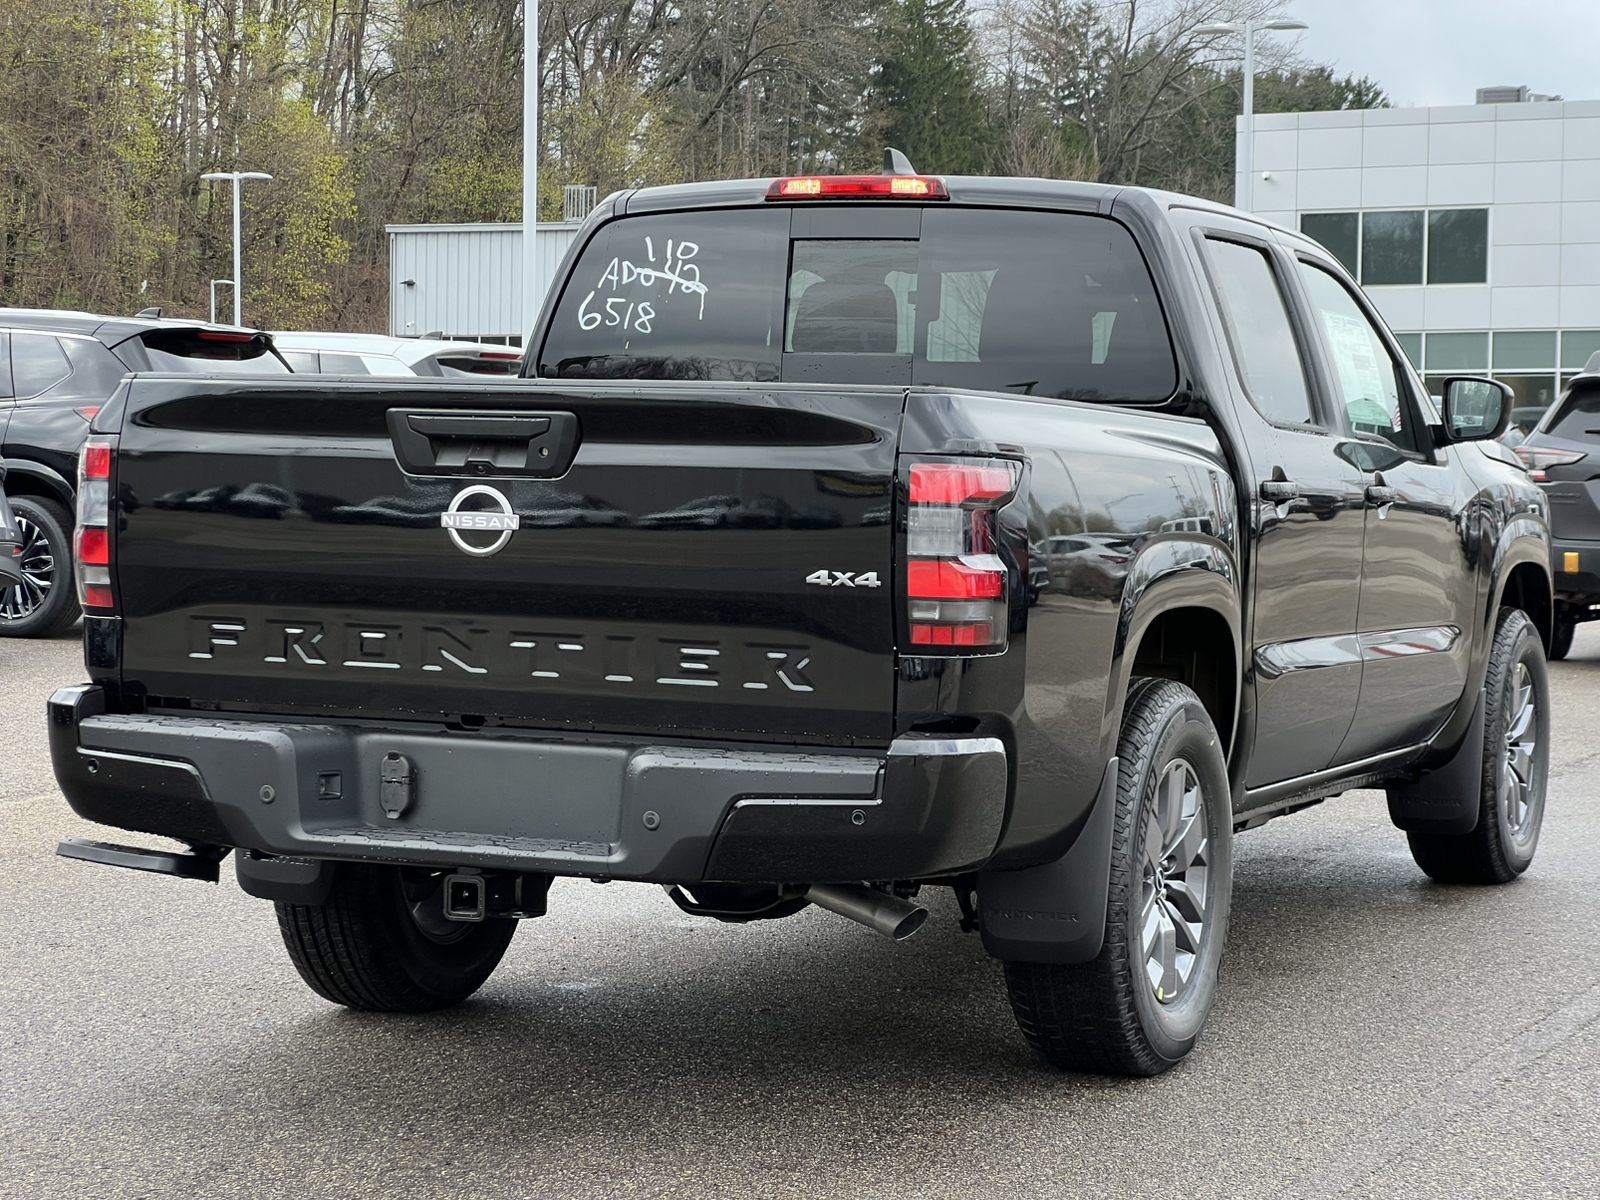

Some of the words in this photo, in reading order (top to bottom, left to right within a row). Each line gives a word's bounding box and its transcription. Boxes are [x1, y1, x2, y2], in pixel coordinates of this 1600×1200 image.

[645, 235, 700, 262] 110
[578, 290, 656, 334] 6518
[443, 514, 518, 529] NISSAN
[188, 614, 815, 693] FRONTIER
